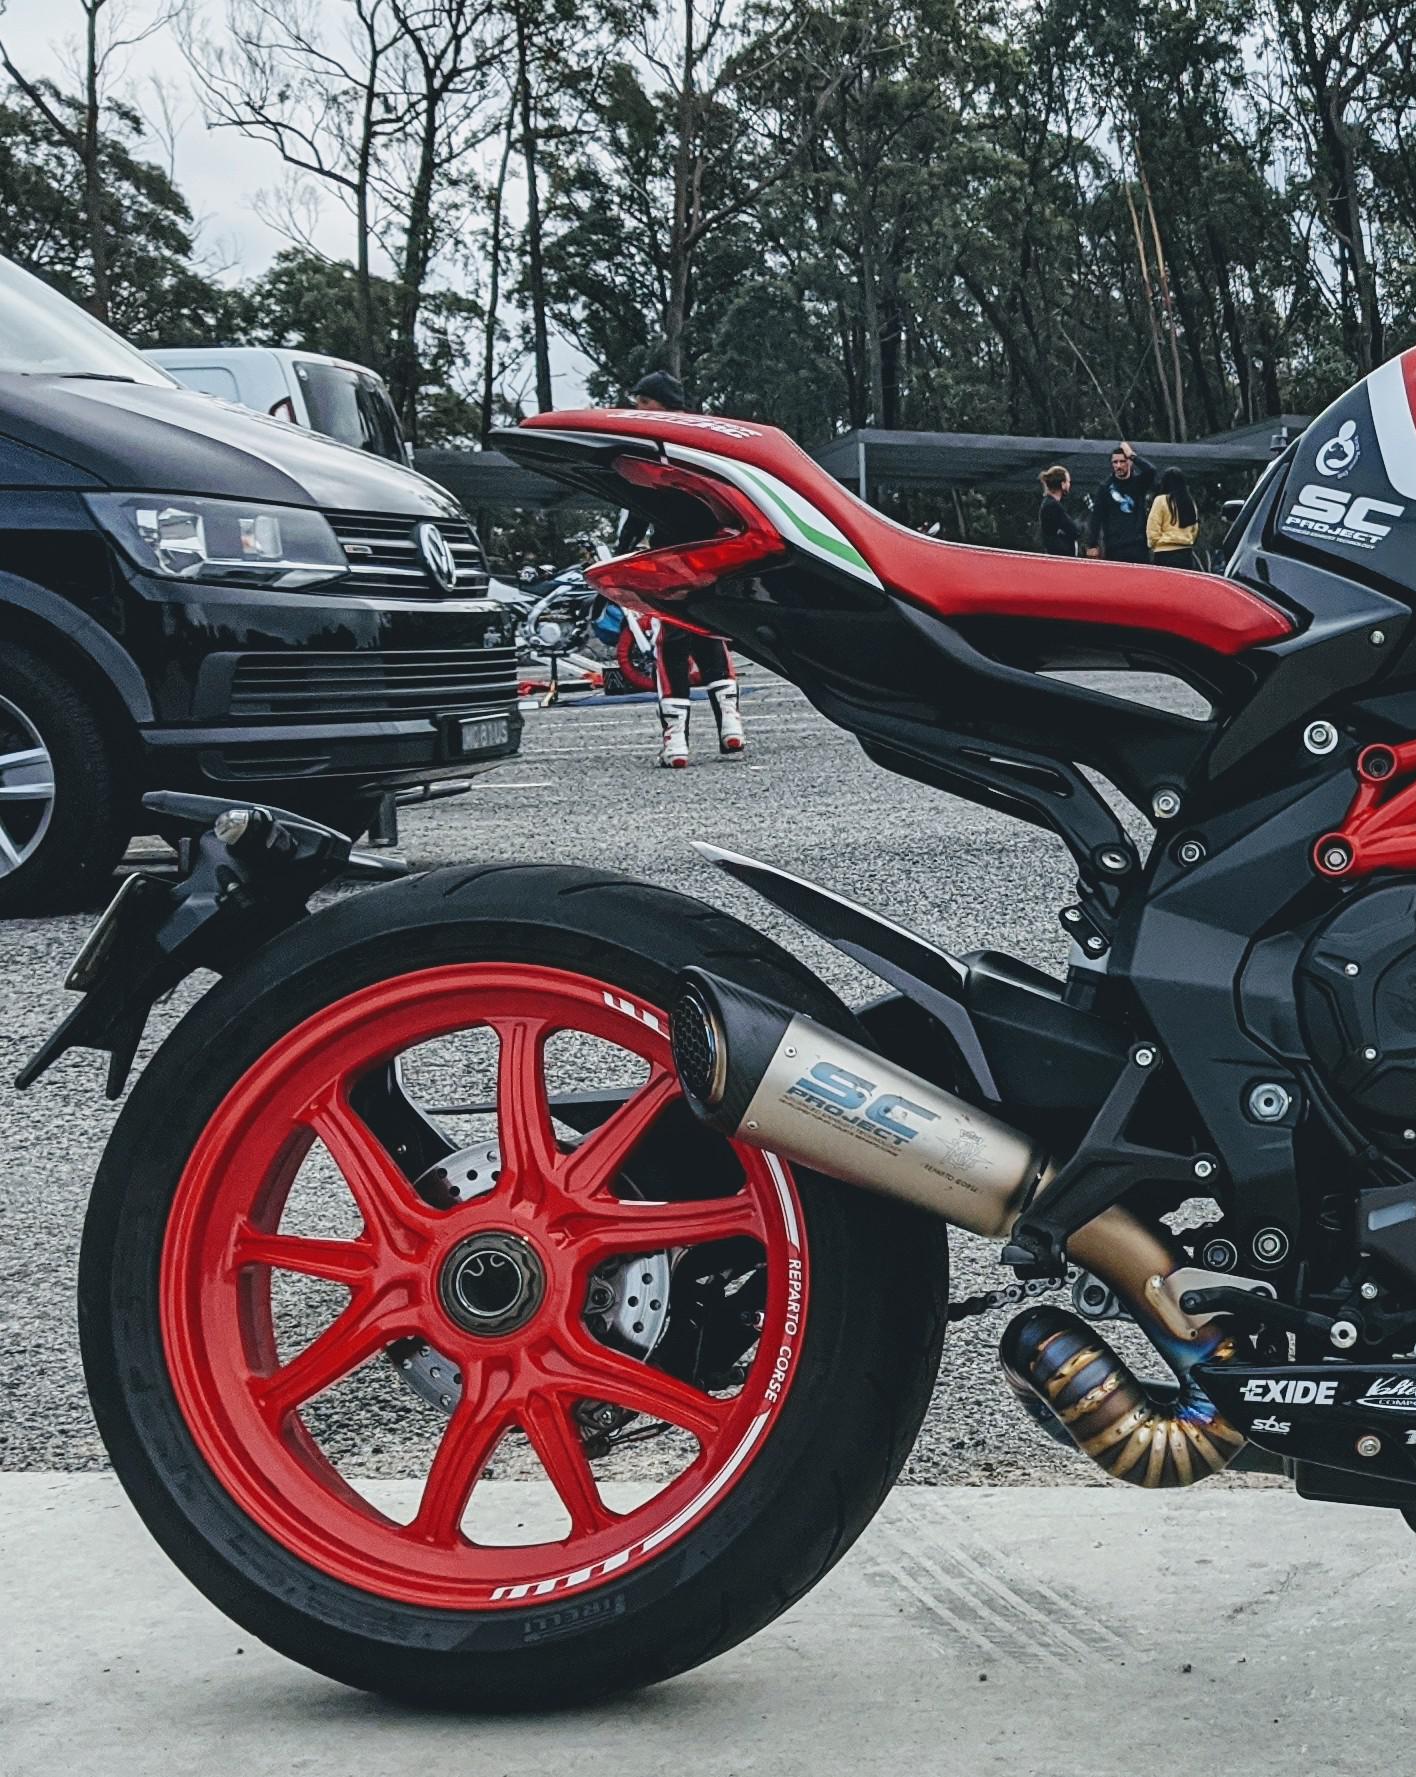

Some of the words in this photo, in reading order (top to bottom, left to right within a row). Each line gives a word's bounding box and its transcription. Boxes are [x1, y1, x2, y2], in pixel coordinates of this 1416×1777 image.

[1286, 516, 1382, 543] PROJECT
[1290, 484, 1405, 536] SC
[785, 1087, 910, 1146] PROJECT
[796, 1062, 941, 1139] SC
[785, 1259, 802, 1336] REPARTO
[765, 1345, 792, 1403] CORSE
[1240, 1379, 1338, 1405] EXIDE
[1251, 1416, 1291, 1433] sbs
